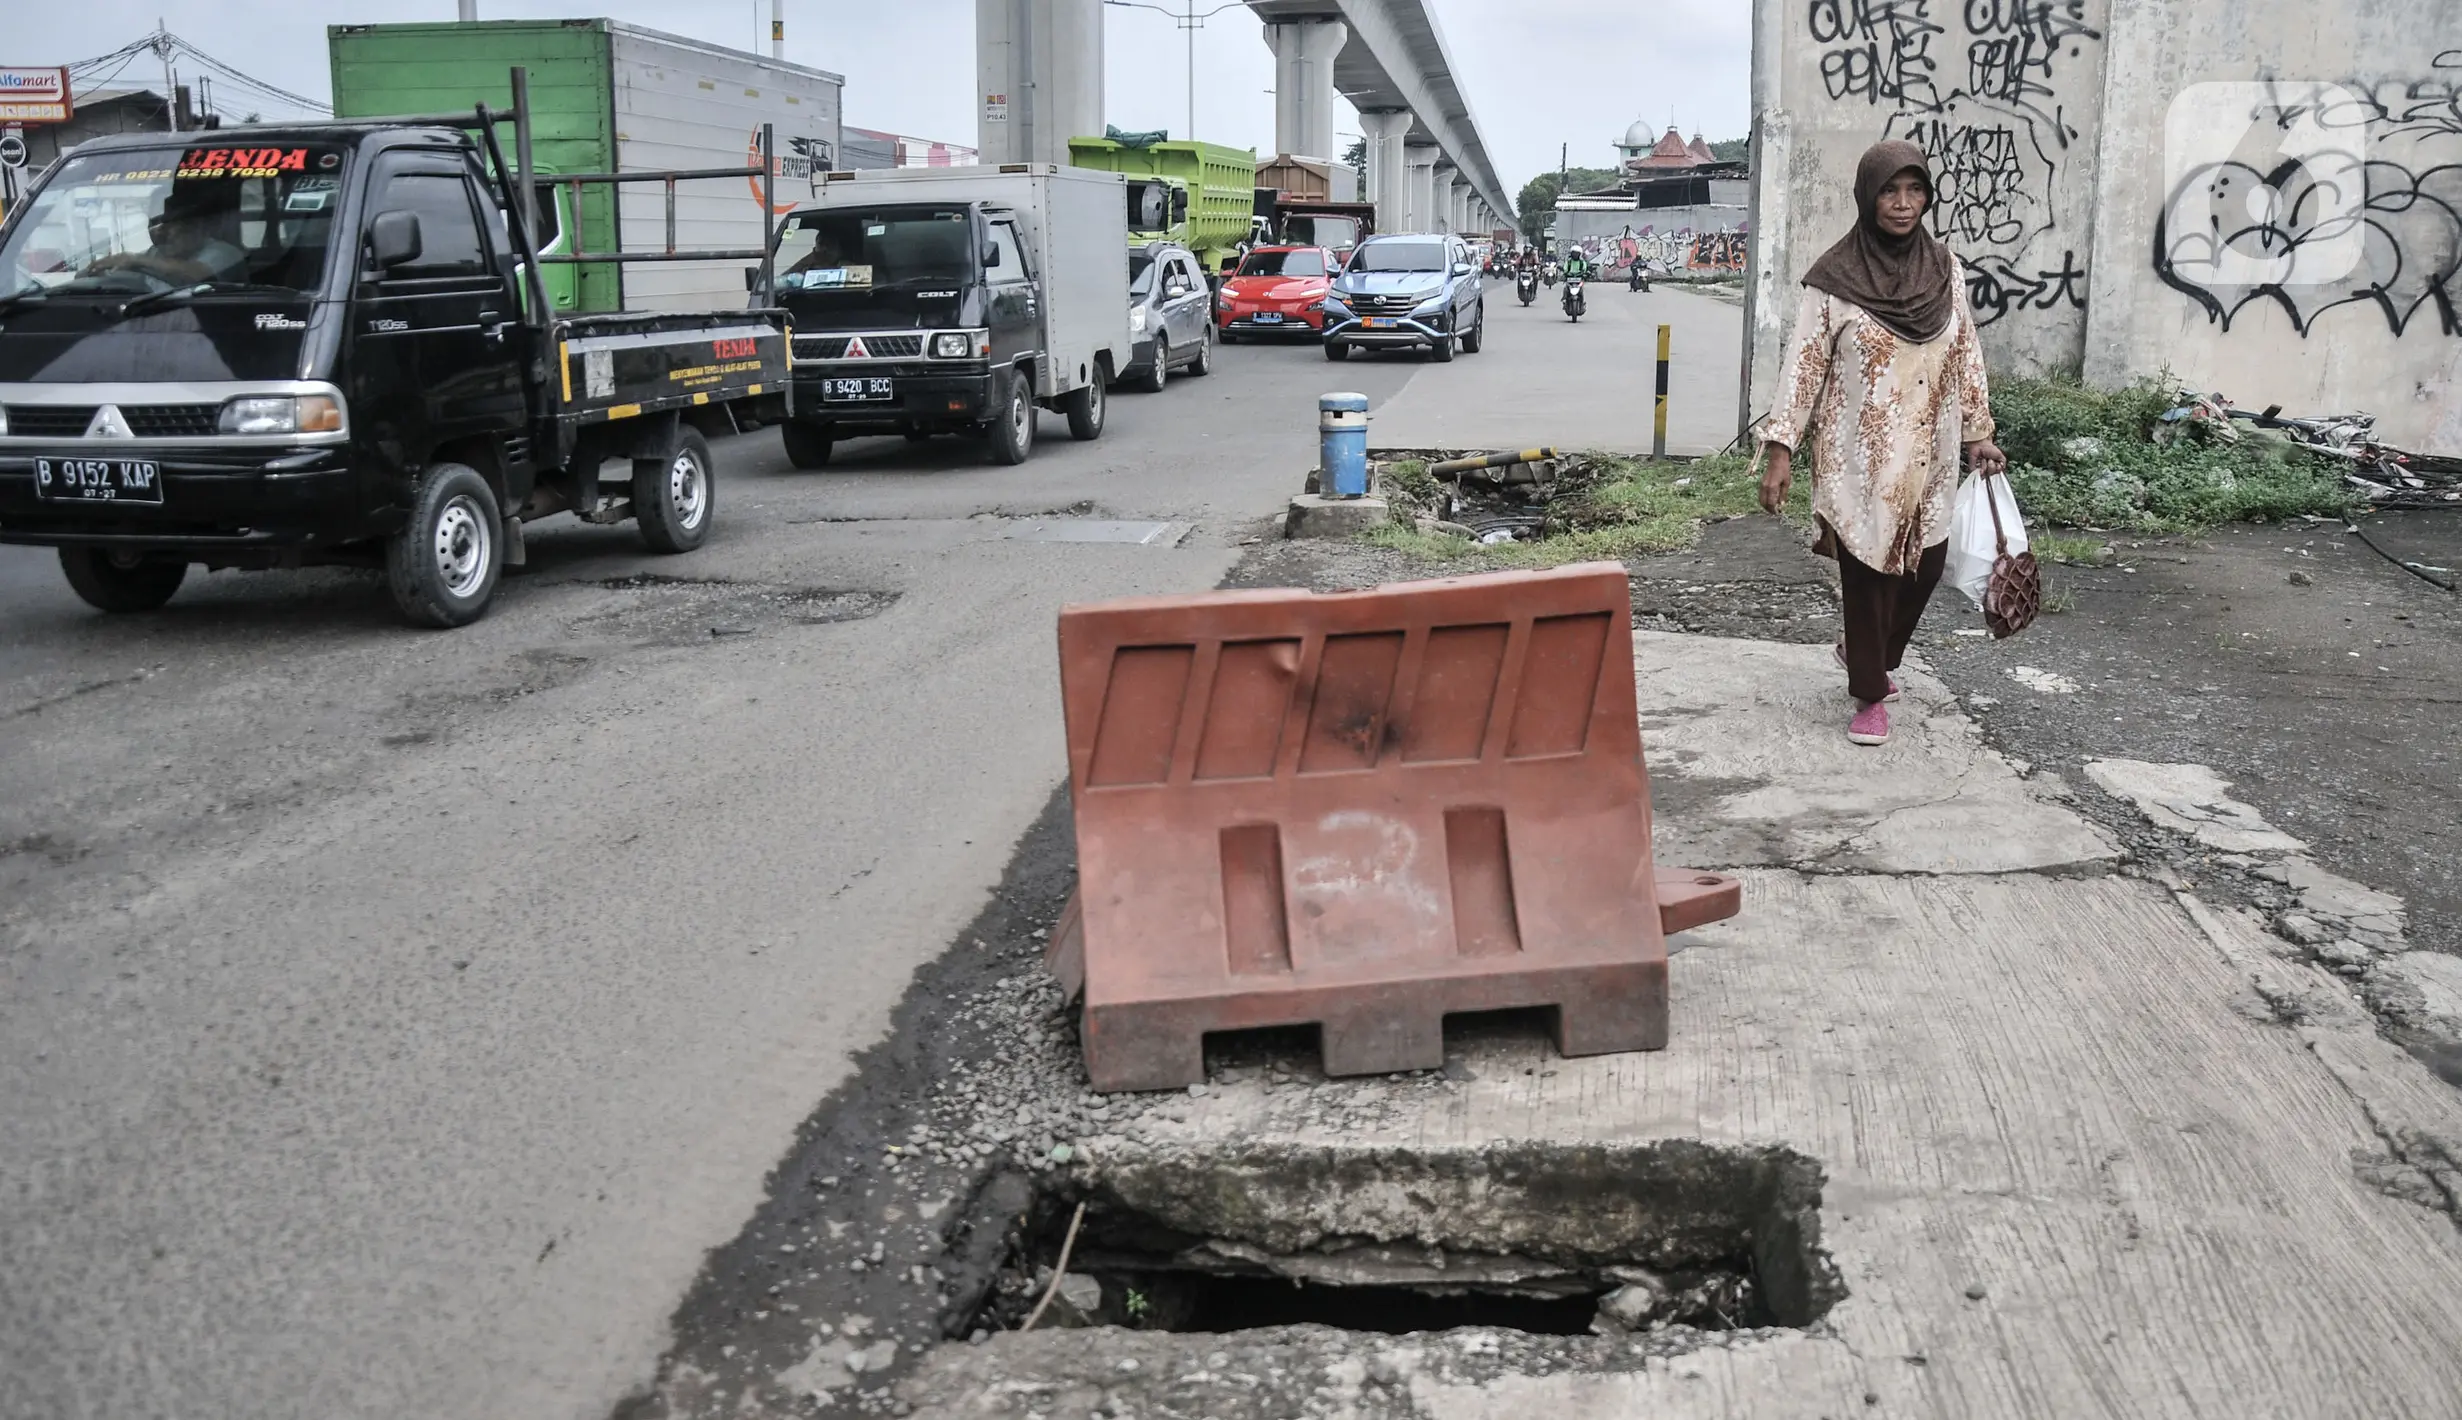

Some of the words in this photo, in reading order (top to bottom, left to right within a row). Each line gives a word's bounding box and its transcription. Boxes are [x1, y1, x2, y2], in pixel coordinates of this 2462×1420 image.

[230, 168, 280, 178] 7020
[917, 290, 958, 298] COLT
[825, 381, 832, 393] B
[837, 380, 862, 393] 9420
[870, 379, 890, 392] BCC
[40, 460, 53, 484] B
[63, 461, 112, 486] 9152
[121, 462, 155, 488] KAP
